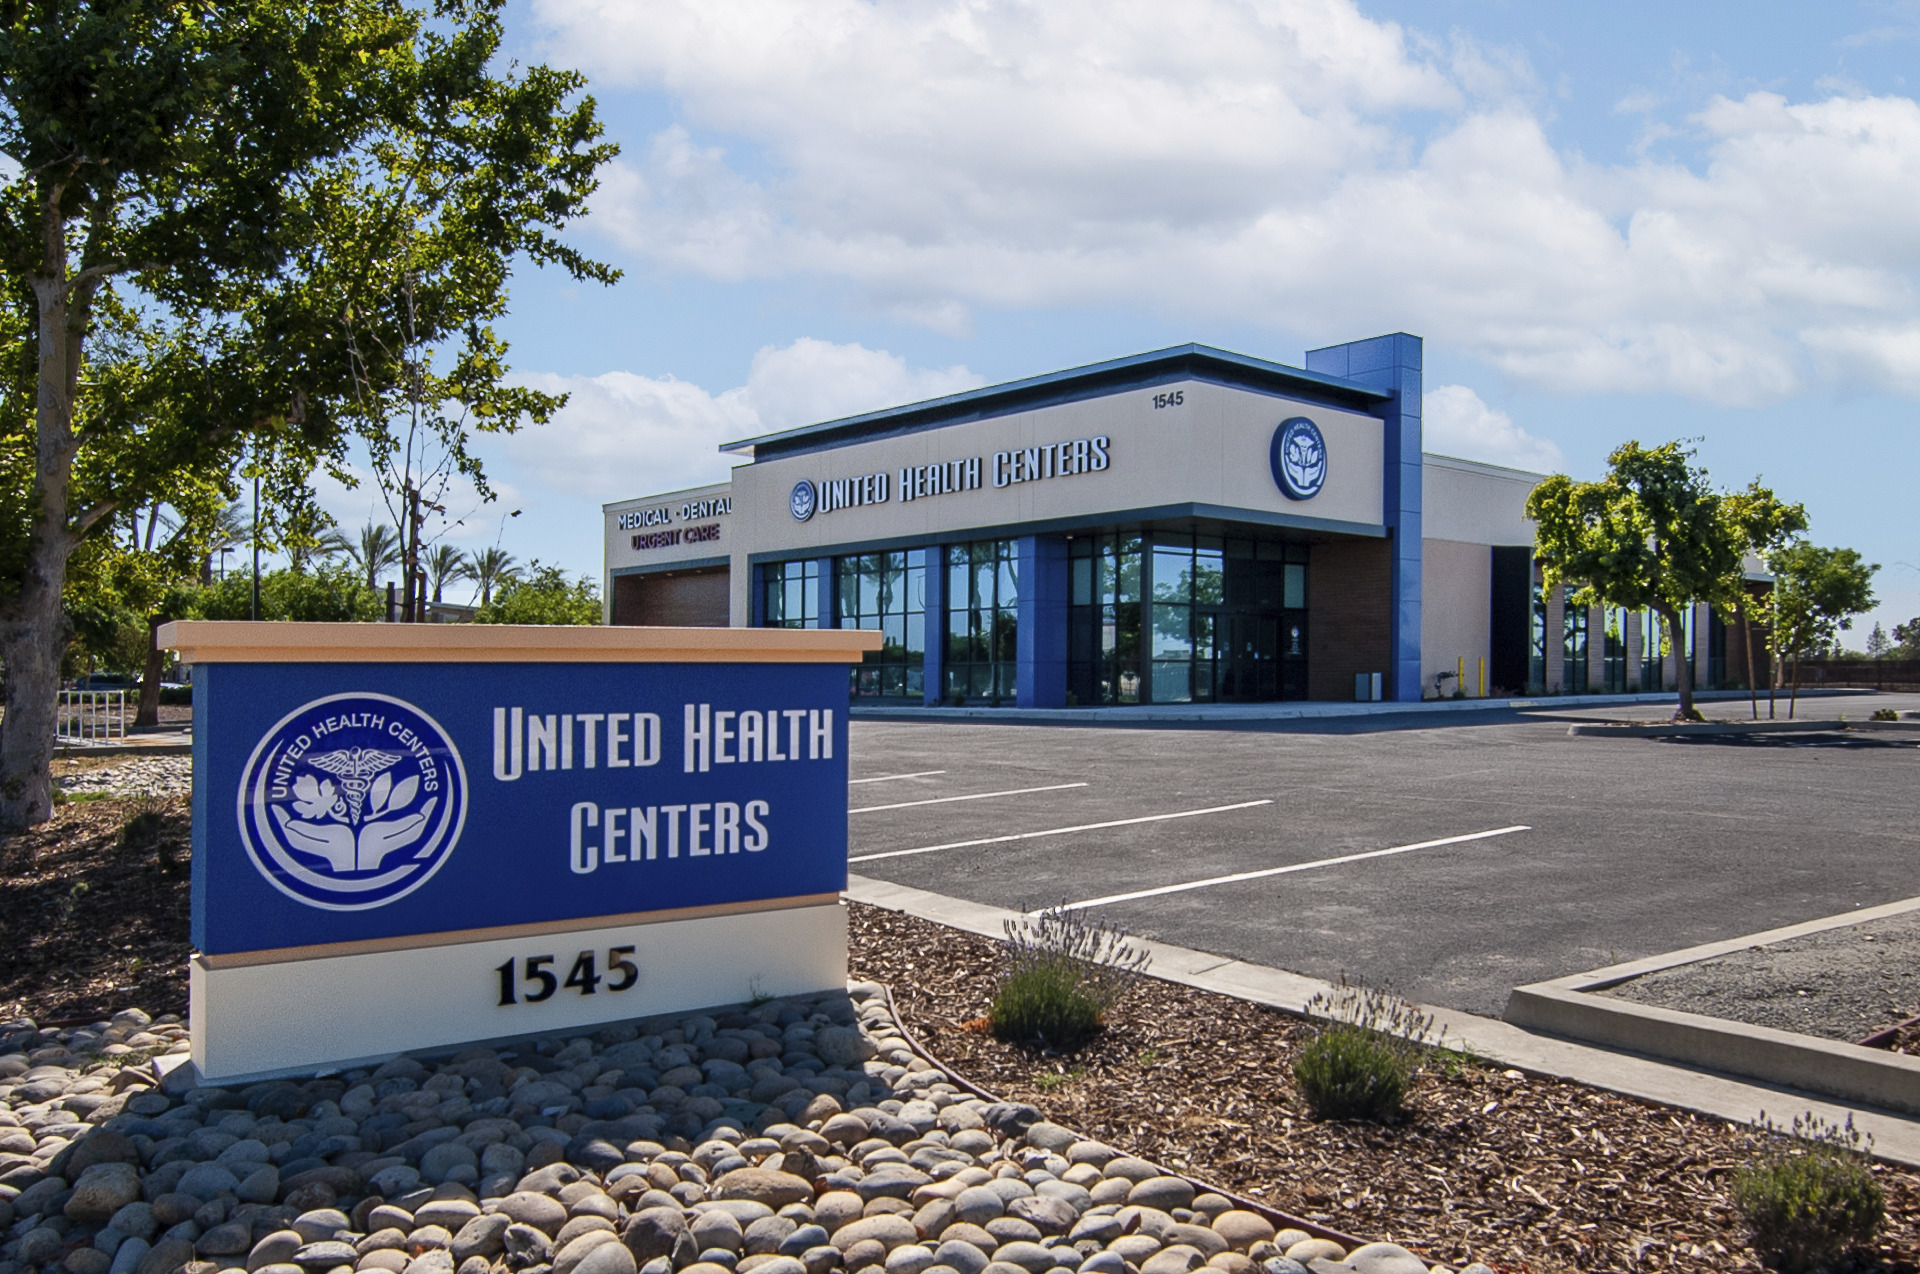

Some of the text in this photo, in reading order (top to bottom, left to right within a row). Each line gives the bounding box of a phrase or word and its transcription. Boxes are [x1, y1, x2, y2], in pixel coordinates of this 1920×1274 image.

[1152, 390, 1184, 410] 1545
[817, 435, 1110, 513] UNITED HEALTH CENTERS
[617, 497, 732, 530] MEDICAL DENTAL
[631, 523, 720, 550] URGENT CARE
[271, 713, 439, 799] UNITED HEALTH CENTERS
[493, 703, 834, 782] UNITED HEALTH
[570, 800, 770, 874] CENTERS
[494, 945, 640, 1007] 1545
